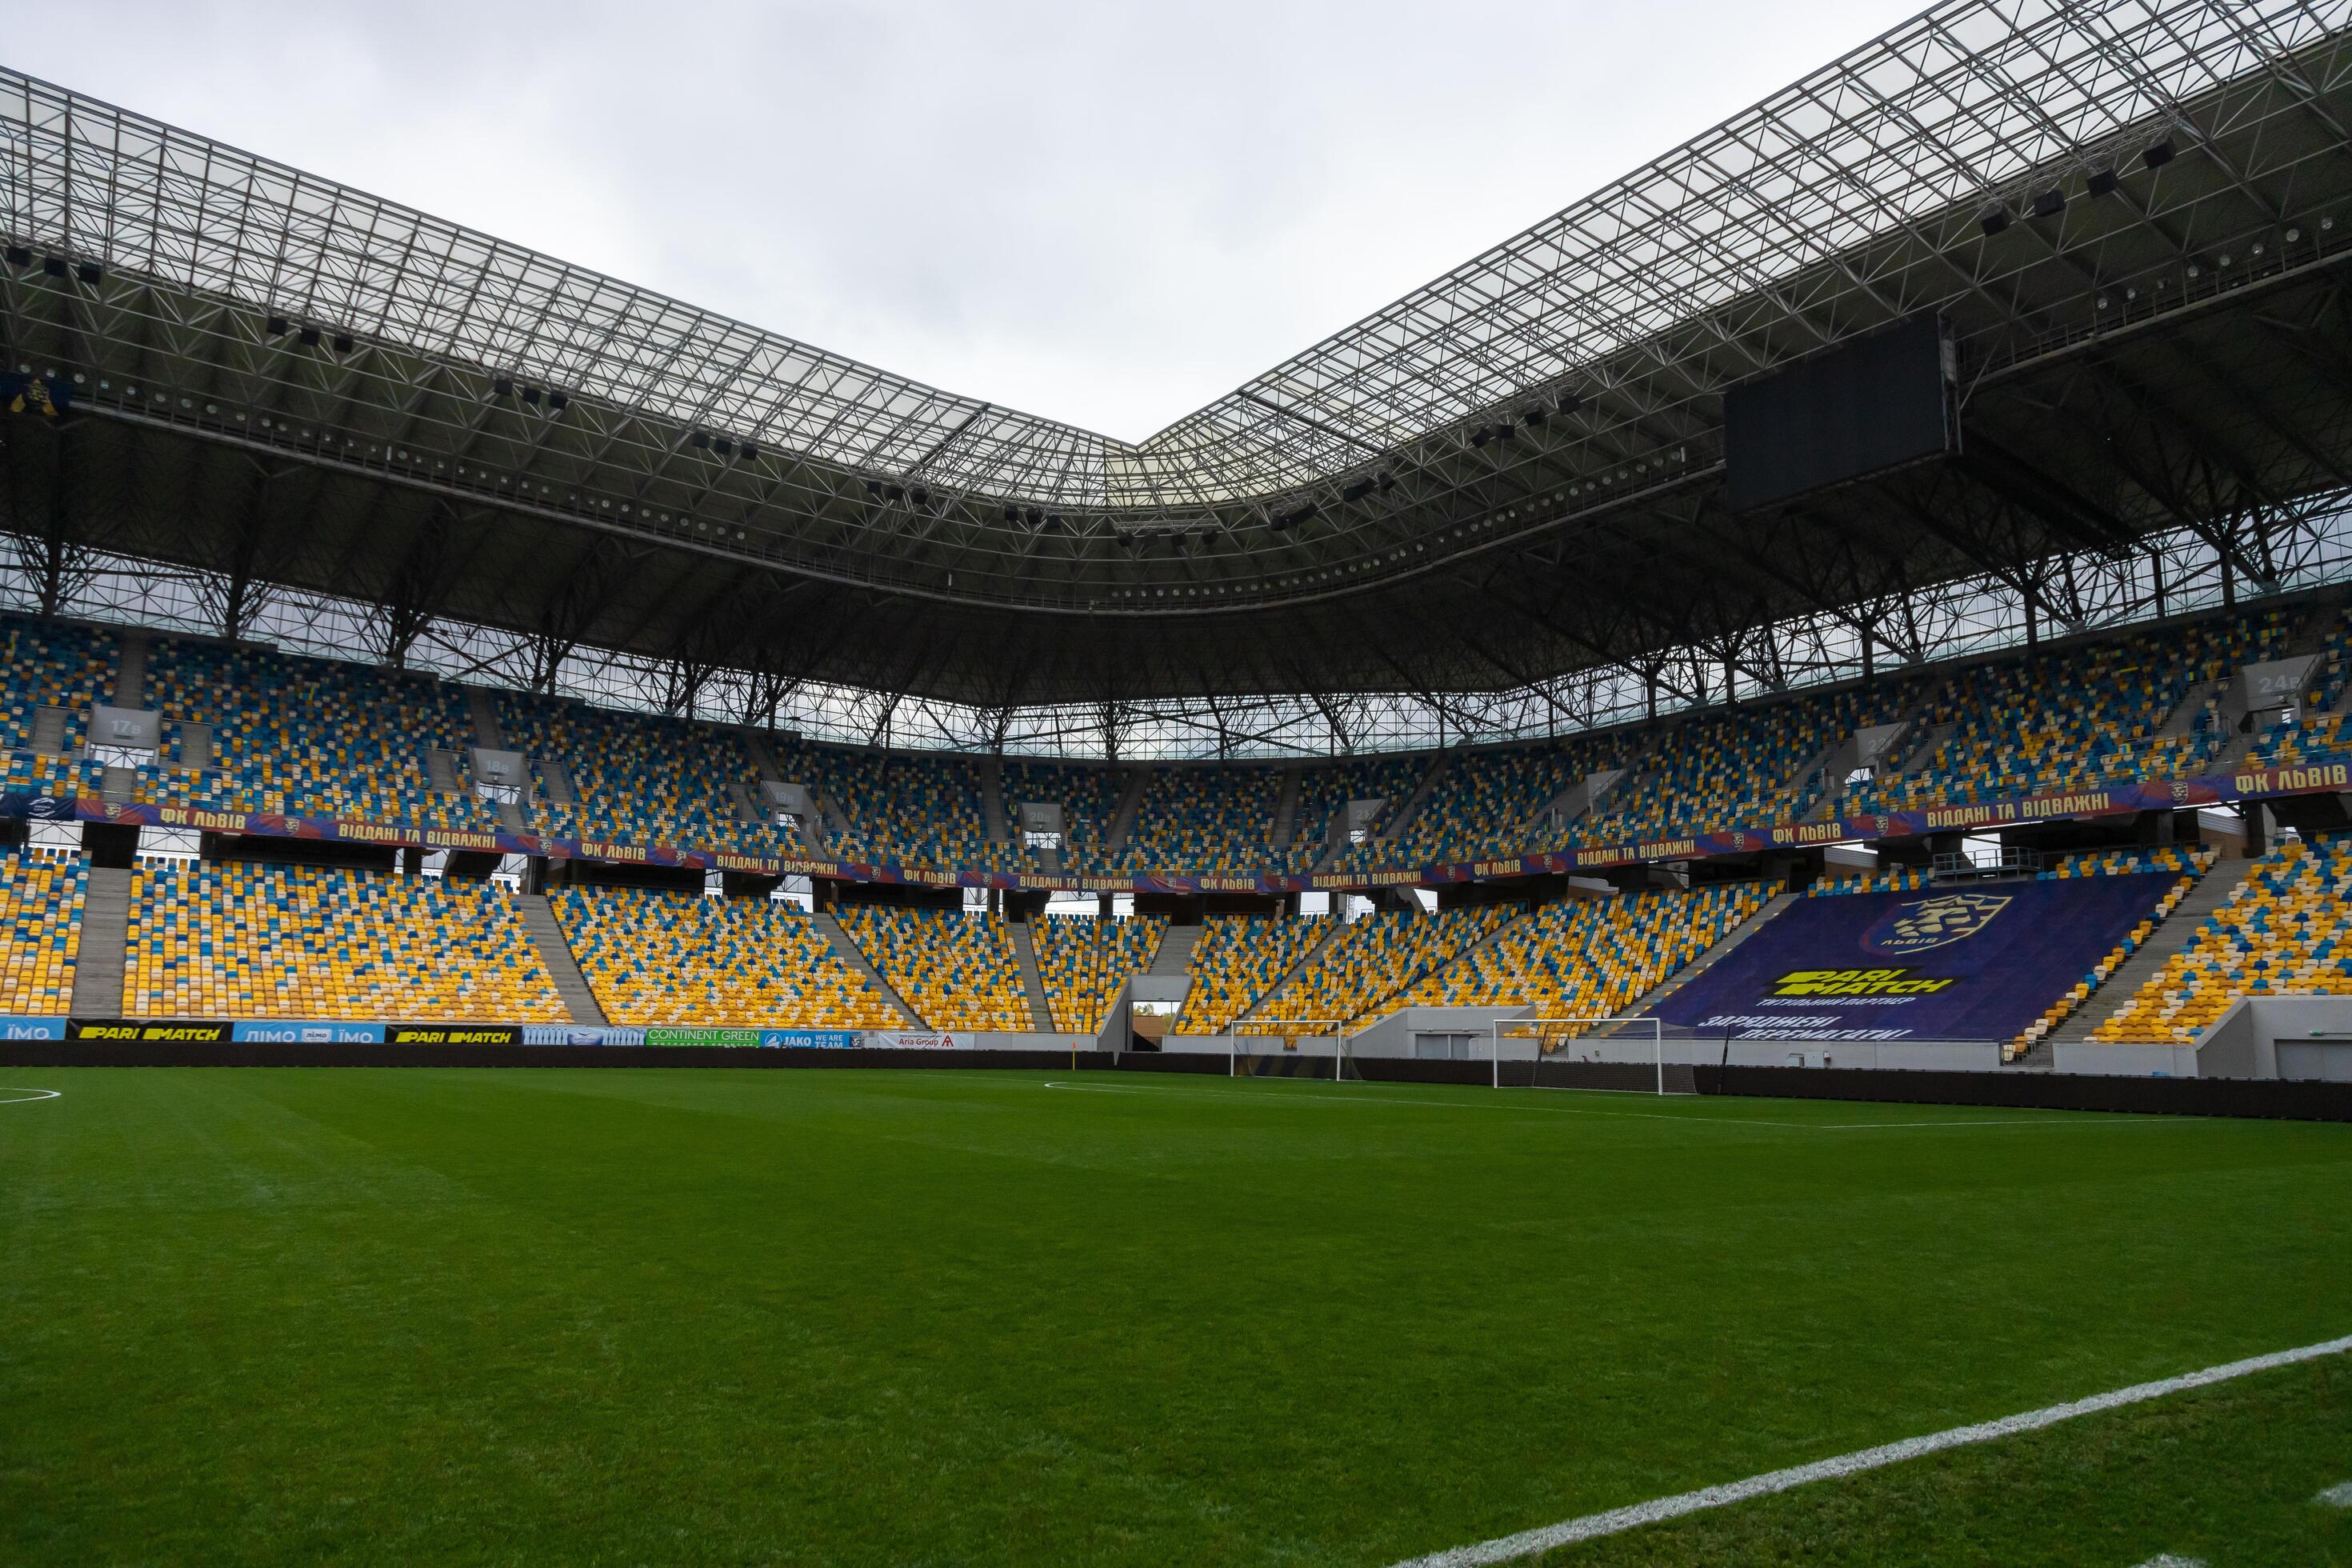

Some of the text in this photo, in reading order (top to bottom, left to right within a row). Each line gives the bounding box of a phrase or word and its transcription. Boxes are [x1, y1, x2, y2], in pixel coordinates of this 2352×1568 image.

[2235, 765, 2347, 794] ФК ЛЬВІВ
[1926, 793, 2110, 828] ВІДДАНІ ТА ВІДВАЖНІ
[161, 808, 246, 830] ФК ЛЬВІВ
[338, 823, 496, 848] ВІДДАНІ ТА ВІДВАЖНІ
[1772, 822, 1842, 844] ФК ЛЬВІВ
[582, 842, 646, 861] ФК ЛЬВІВ
[1578, 839, 1694, 866] ВІДДАНІ ТА ВІДВАЖНІ
[717, 855, 838, 875] ВІДДАНІ ТА ВІДВАЖНІ
[1474, 859, 1521, 876] ФК ЛЬВІВ
[903, 870, 956, 884] ФК ЛЬВІВ
[1019, 875, 1134, 890] ВІДДАНІ ТА ВІДВАЖНІ
[1200, 878, 1255, 890] ФК ЛЬВІВ
[1313, 870, 1421, 887] ВІДДАНІ ТА ВІДВАЖНІ
[1880, 938, 1938, 946] ЛЬВІВ
[1775, 969, 1907, 983] PARI
[1773, 979, 1954, 994] MATCH
[1756, 997, 1916, 1006] ТИТУЛЬНИЙ ПАРТНЕР
[1698, 1015, 1842, 1028] ЗАРЯДЖЕНІ
[79, 1026, 221, 1041] PARI MATCH
[245, 1030, 297, 1042] ЛІМО
[396, 1032, 511, 1043] PARI MATCH
[649, 1030, 759, 1041] CONTINENT GREEN
[783, 1036, 812, 1046] JAKO
[1735, 1029, 1914, 1039] ПЕРЕМАГАТИ!
[898, 1038, 938, 1047] Aria Group
